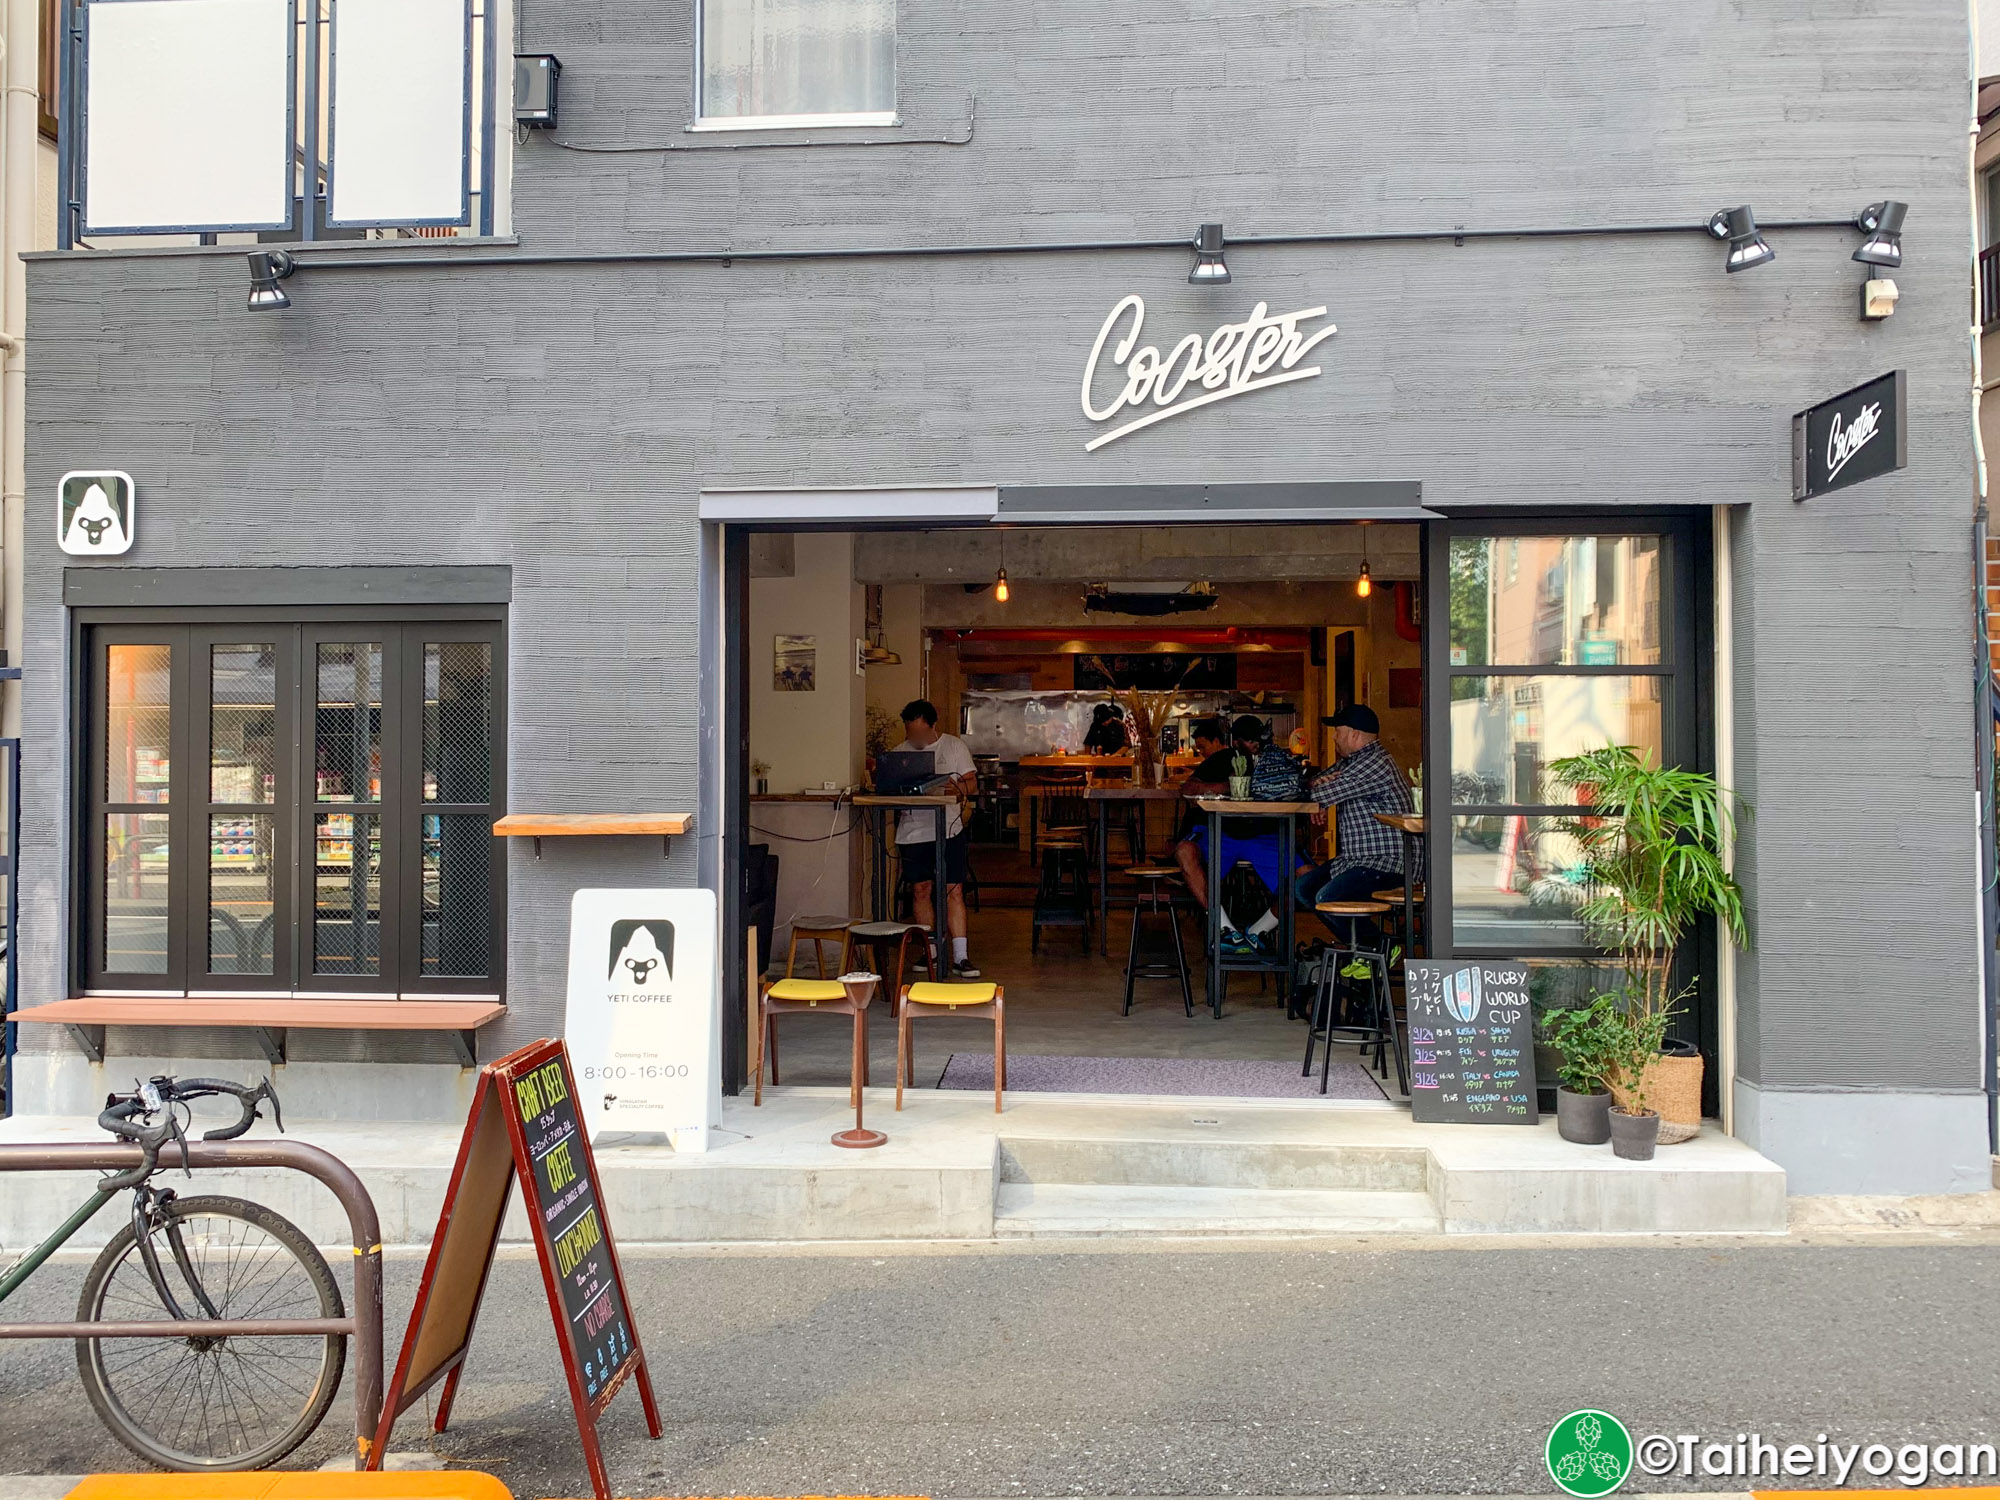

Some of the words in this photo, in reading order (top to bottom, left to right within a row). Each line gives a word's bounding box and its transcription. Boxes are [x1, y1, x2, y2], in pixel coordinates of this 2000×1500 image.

[1081, 294, 1338, 423] Coaster
[1827, 402, 1882, 471] Coaster
[1484, 970, 1527, 986] RUGBY
[607, 994, 629, 1003] YETI
[632, 994, 672, 1003] COFFEE
[1485, 991, 1529, 1006] WORLD
[1489, 1010, 1521, 1024] CUP
[1413, 1027, 1434, 1042] 9/24
[1414, 1048, 1436, 1062] 9/25
[1415, 1072, 1438, 1086] 9/26
[516, 1071, 546, 1123] CRAFT
[541, 1062, 568, 1107] BEER
[1510, 1094, 1528, 1103] USA
[546, 1141, 576, 1193] COFFEE
[584, 1311, 597, 1342] NO
